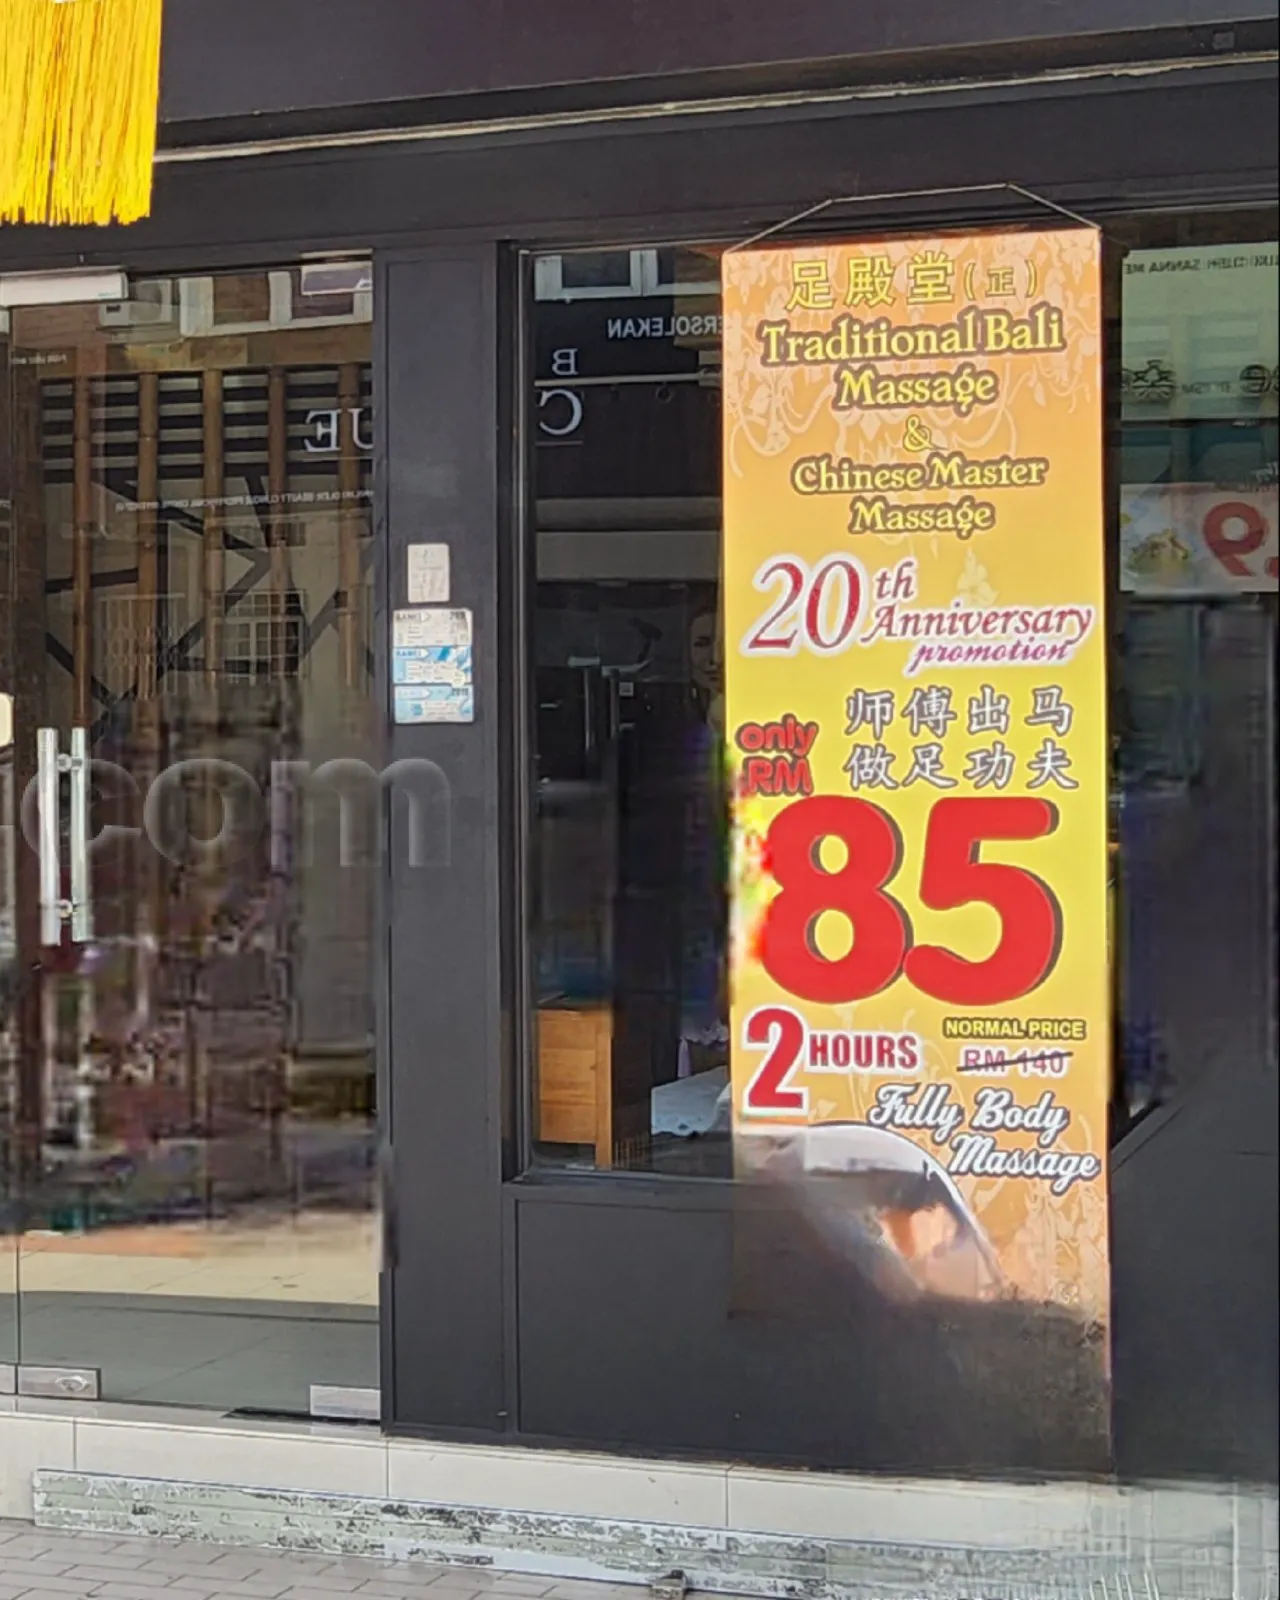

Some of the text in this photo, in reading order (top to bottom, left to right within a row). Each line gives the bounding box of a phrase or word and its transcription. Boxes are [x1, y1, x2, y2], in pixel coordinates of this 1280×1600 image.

[762, 306, 1065, 364] Traditional Bali
[837, 367, 997, 414] Massage
[903, 415, 946, 452] &
[792, 455, 1048, 494] Chinese Master
[850, 502, 995, 538] Massage
[861, 601, 1093, 646] Anniversary
[908, 638, 1070, 674] promotion
[736, 714, 819, 759] only
[743, 756, 814, 796] RM
[844, 741, 1079, 790] 做足功夫
[760, 795, 1063, 1006] 85
[944, 1018, 1086, 1040] NORMAL PRICE
[746, 1008, 918, 1109] 2 HOURS
[963, 1049, 1065, 1075] RM 140
[870, 1083, 1068, 1147] Fully Body
[950, 1133, 1102, 1194] Massage
